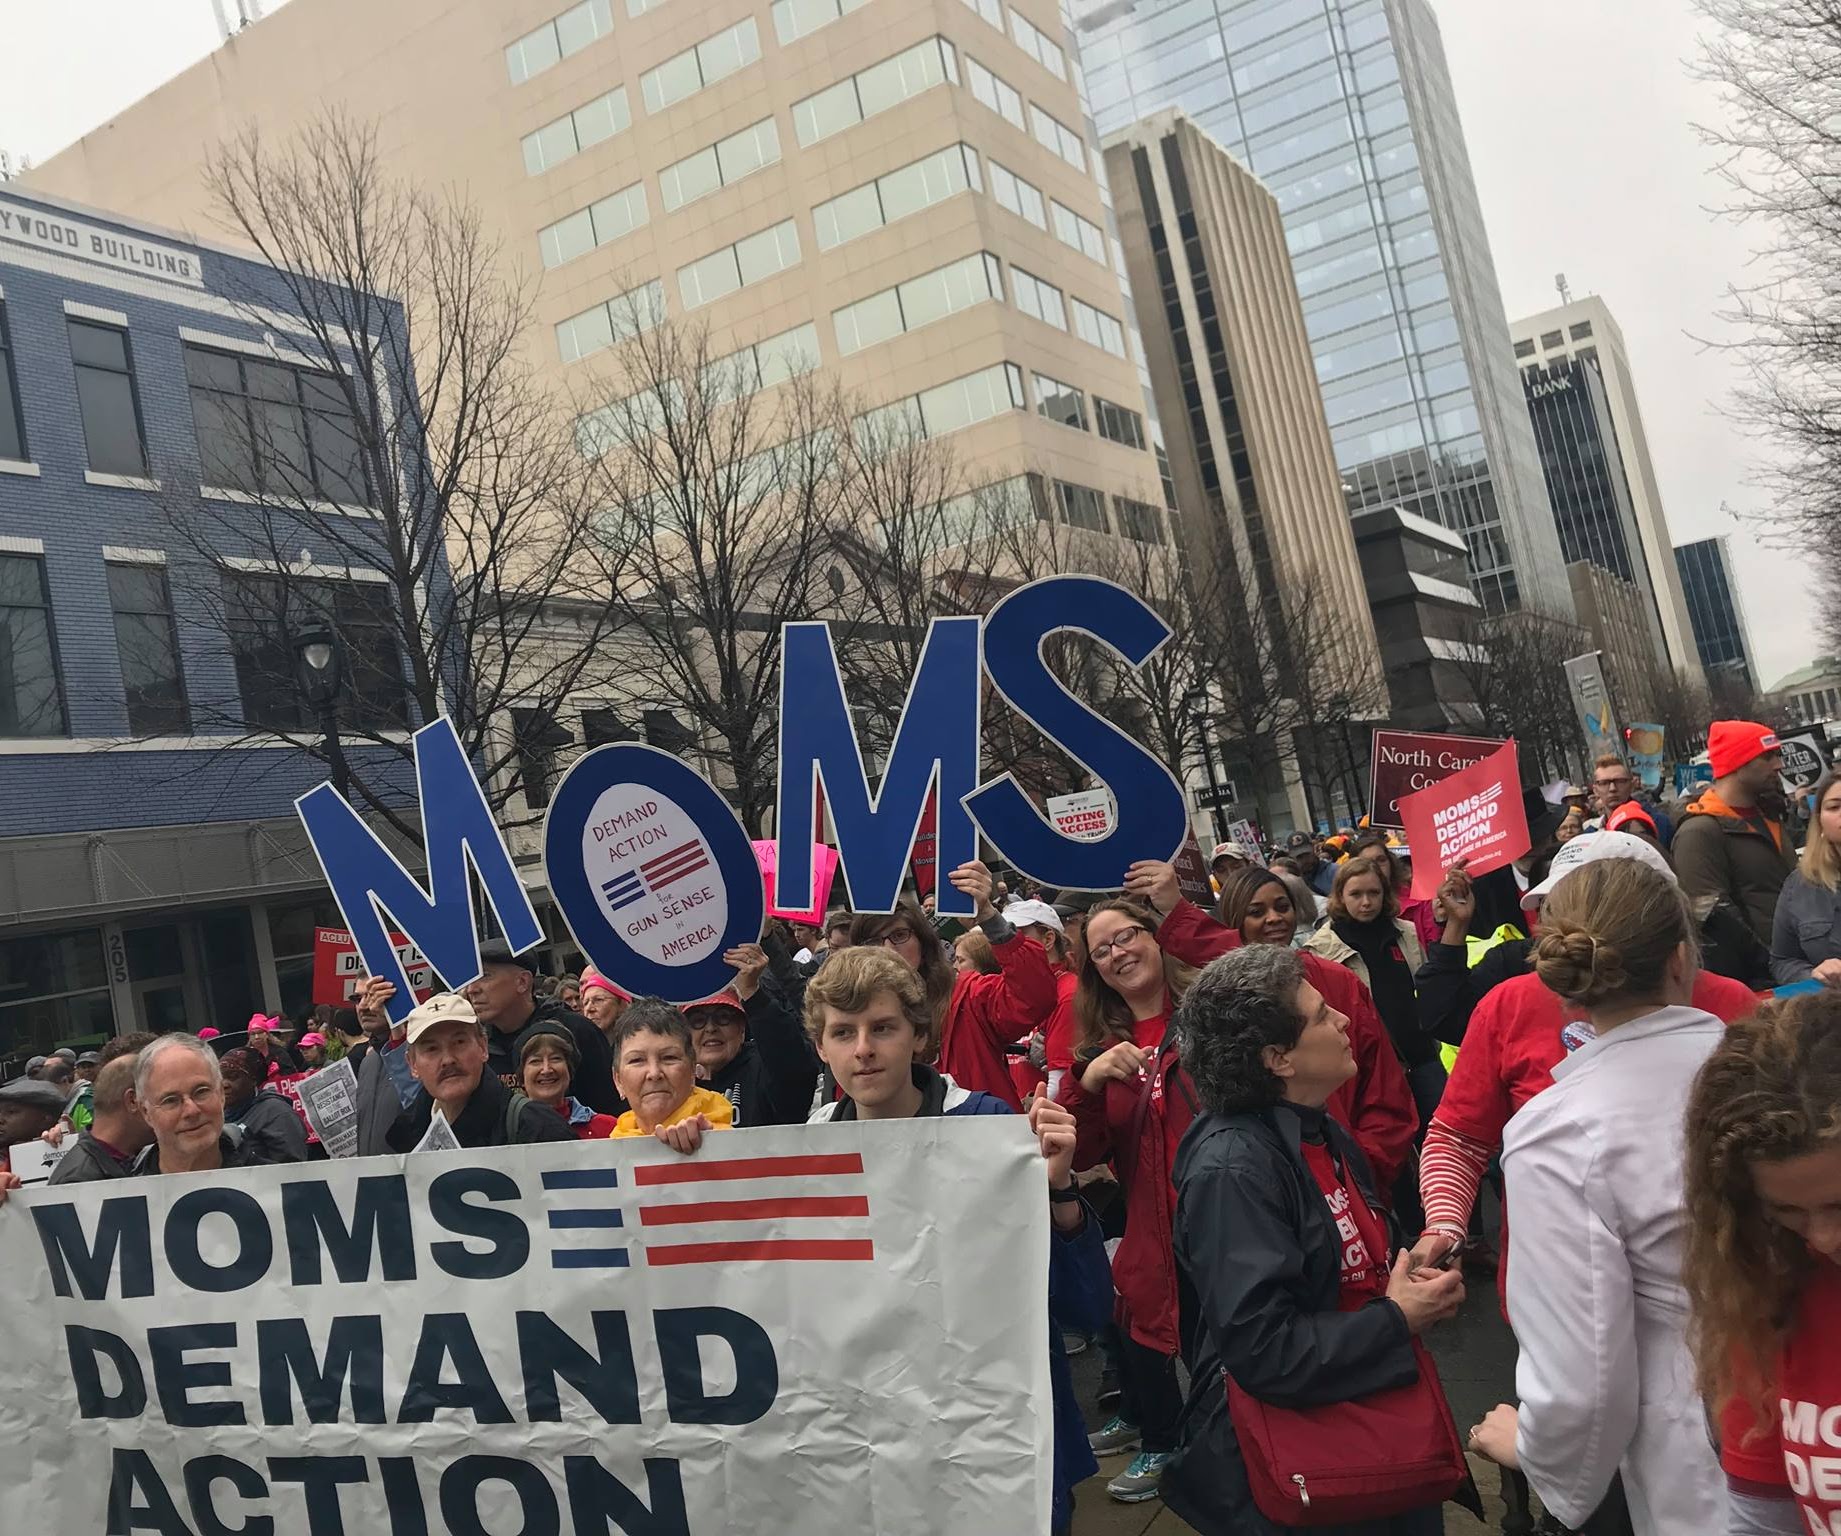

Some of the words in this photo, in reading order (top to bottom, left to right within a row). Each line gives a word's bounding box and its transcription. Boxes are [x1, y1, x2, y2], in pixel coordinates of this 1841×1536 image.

[90, 234, 190, 277] BUILDING
[1532, 375, 1572, 398] BANK
[1380, 746, 1431, 767] North
[592, 801, 658, 842] DEMAND
[1056, 810, 1106, 825] VOTING
[1433, 794, 1480, 827] MOMS
[1436, 802, 1498, 842] DEMAND
[608, 824, 668, 862] ACTION
[1440, 820, 1491, 858] ACTION
[627, 913, 659, 936] GUN
[662, 886, 716, 920] SENSE
[675, 920, 684, 930] IN
[321, 932, 349, 944] ACLU
[661, 924, 718, 960] AMERICA
[109, 934, 127, 983] 205
[316, 1089, 347, 1109] RESISTANCE
[322, 1109, 341, 1125] BALLOT
[340, 1105, 352, 1116] BOX
[29, 1166, 532, 1300] MOMS
[64, 1305, 780, 1426] DEMAND
[104, 1447, 689, 1536] ACTION
